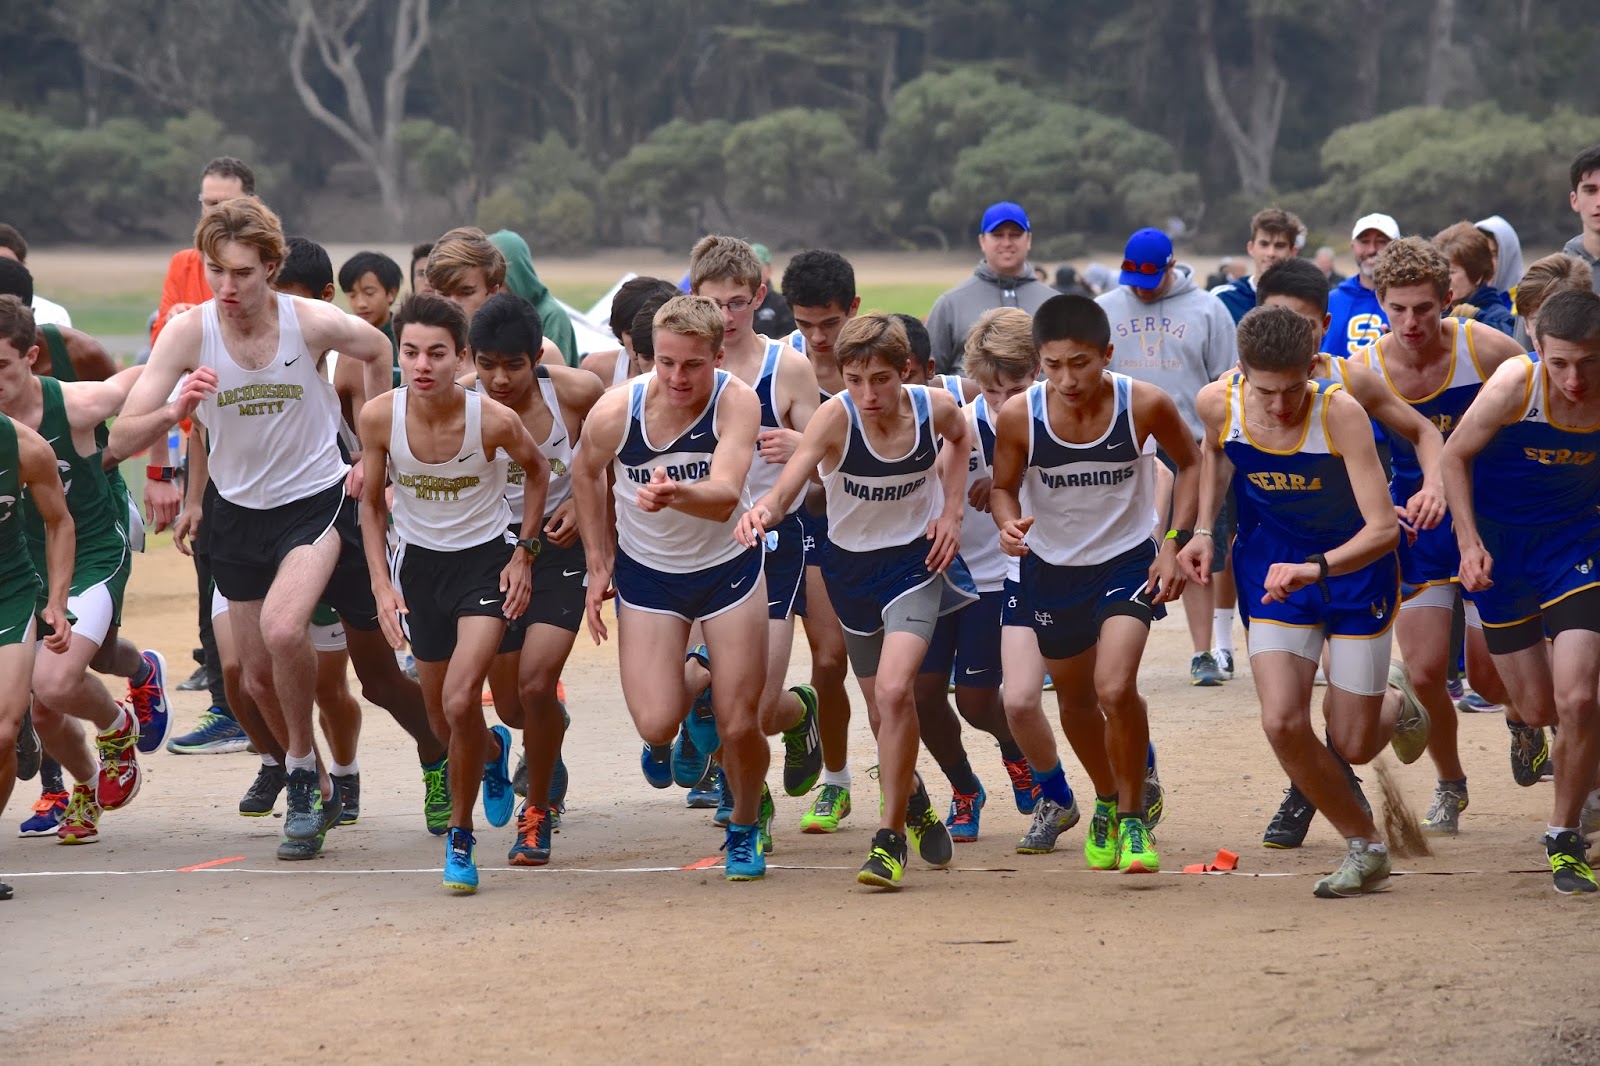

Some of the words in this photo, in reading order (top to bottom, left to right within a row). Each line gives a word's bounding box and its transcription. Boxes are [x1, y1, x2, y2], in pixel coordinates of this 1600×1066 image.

[1116, 316, 1186, 338] SERRA
[217, 384, 304, 407] ARCHBISHOP
[238, 400, 284, 416] MITTY
[627, 460, 713, 485] WARIOR
[1038, 466, 1135, 488] WARRIORS
[1247, 472, 1322, 491] SERRA
[415, 487, 459, 501] MITTY
